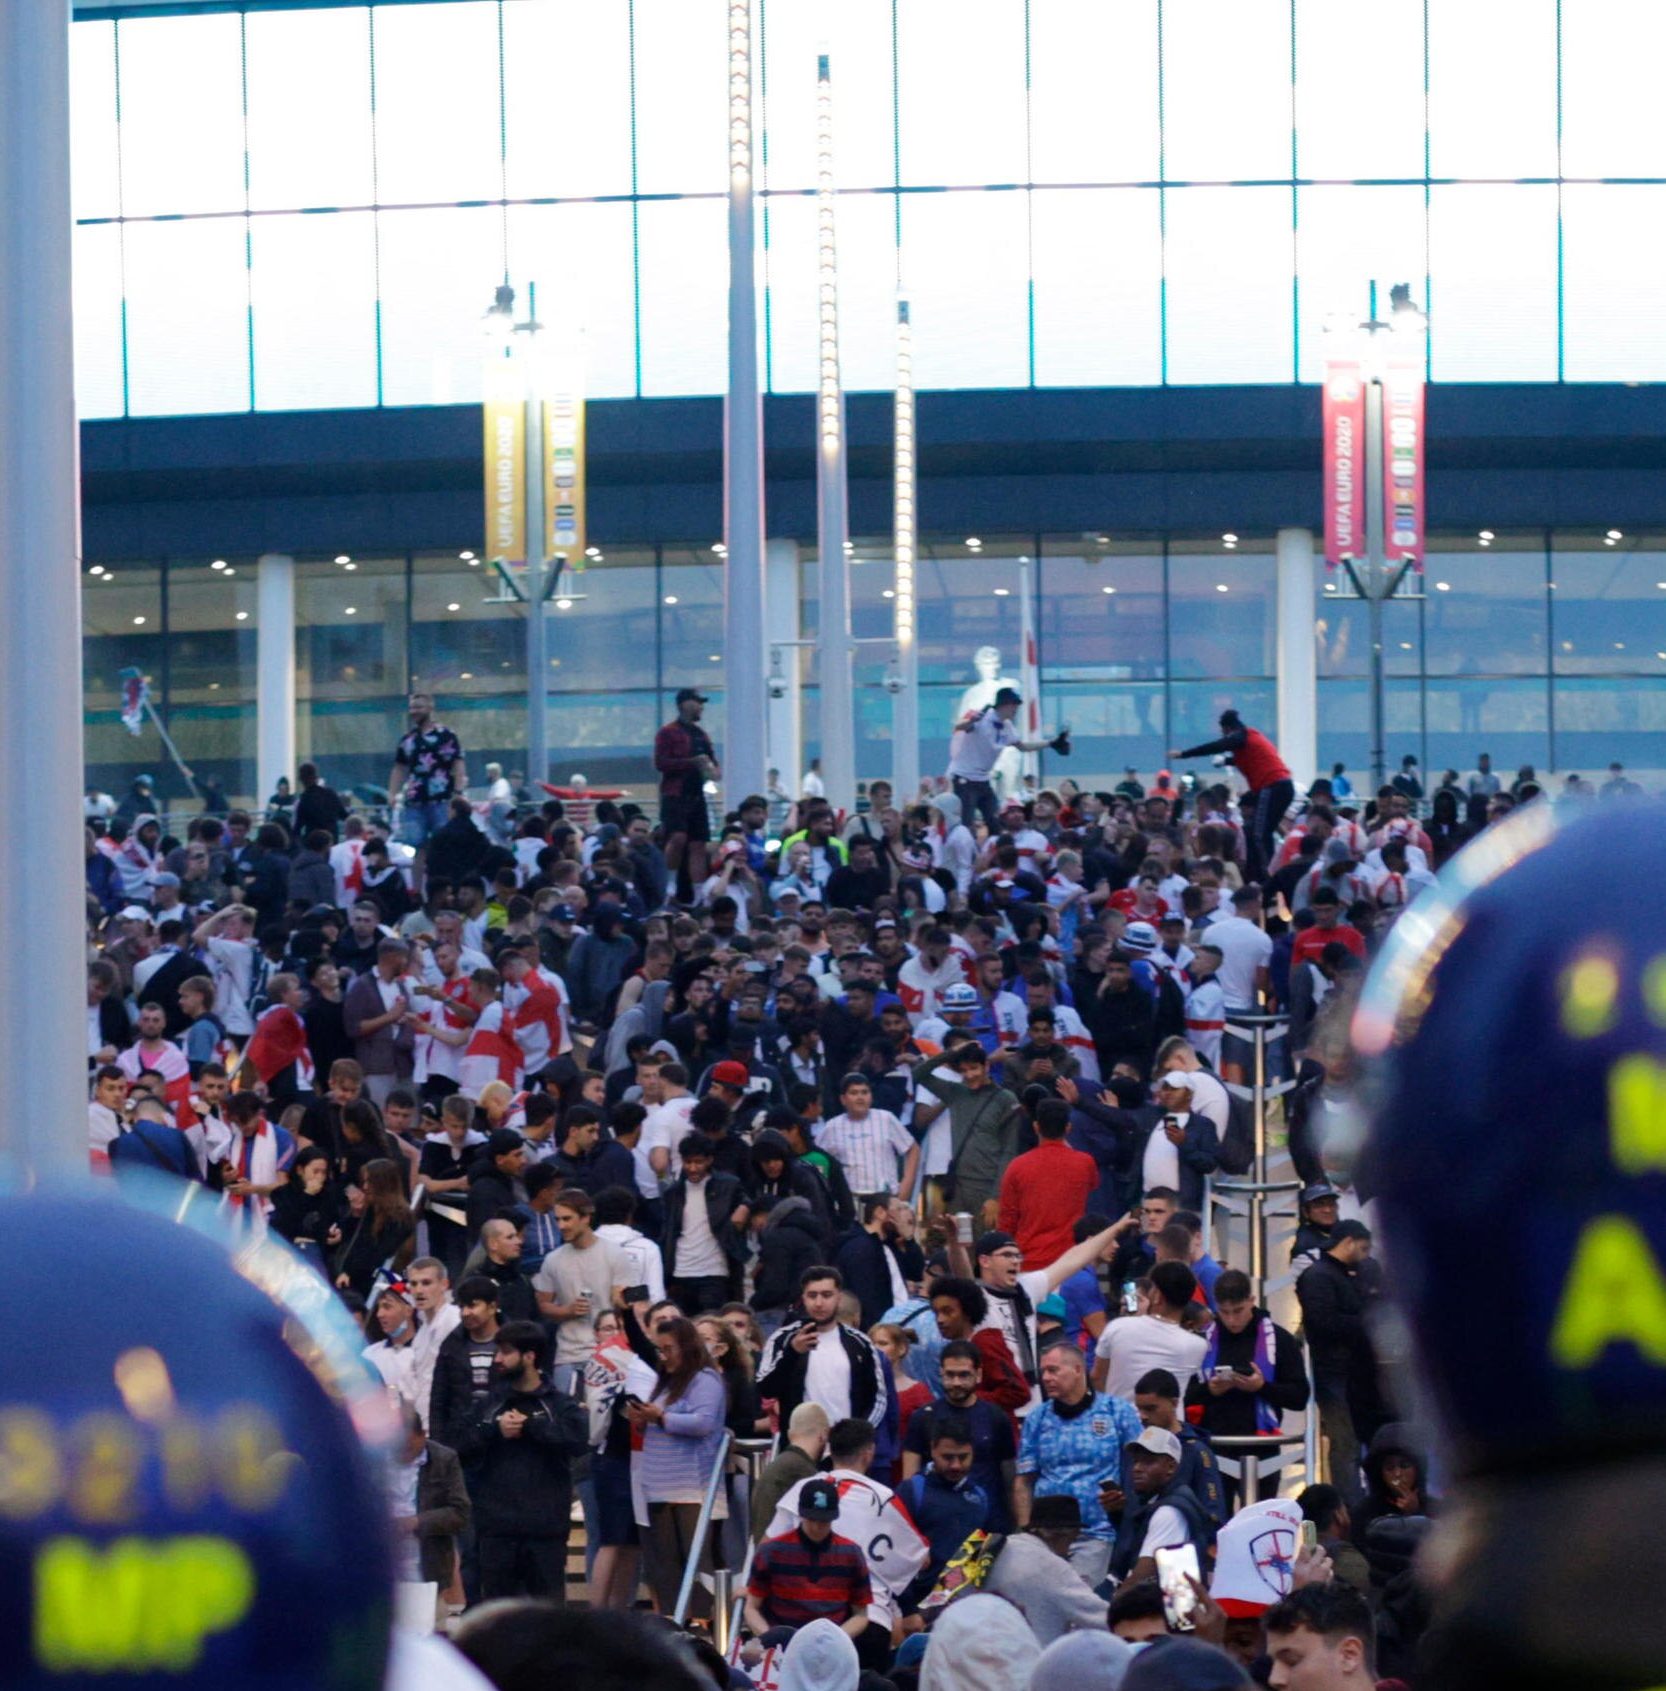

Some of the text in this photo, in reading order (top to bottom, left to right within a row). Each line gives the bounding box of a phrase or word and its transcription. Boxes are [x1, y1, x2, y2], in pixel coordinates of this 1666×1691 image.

[497, 458, 514, 503] EURO
[1335, 416, 1353, 547] UEFA EURO 2020
[497, 504, 514, 547] UEFA
[36, 1537, 255, 1670] MP
